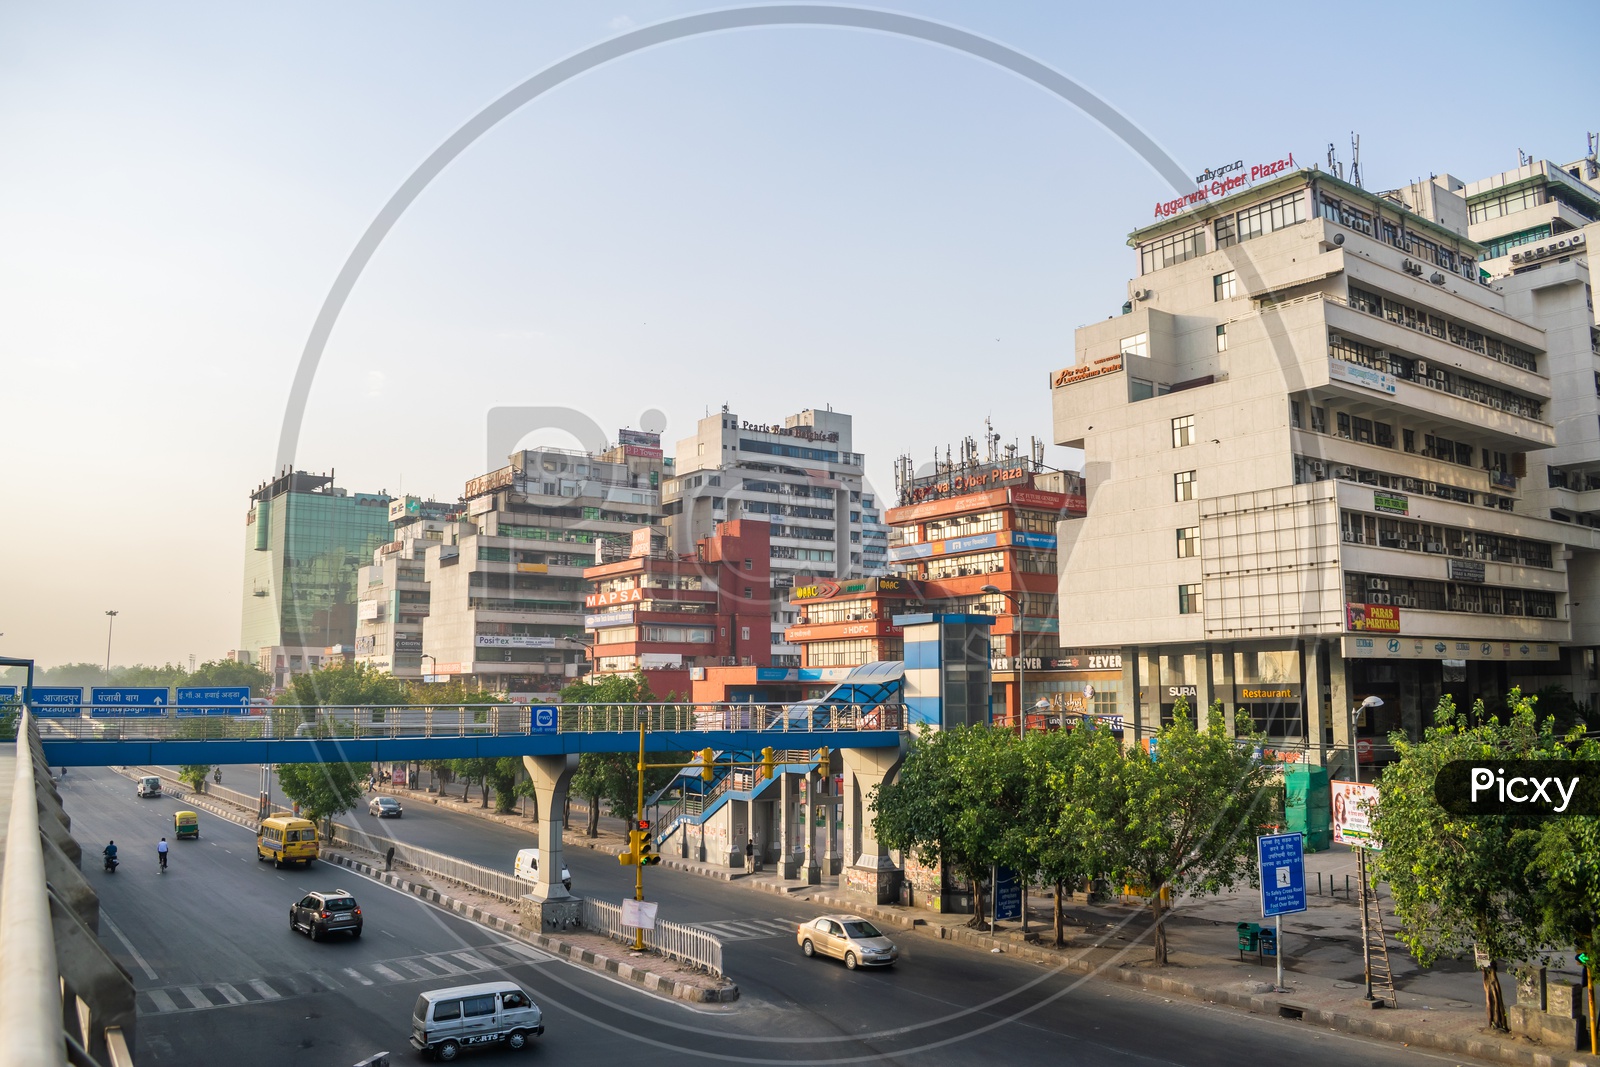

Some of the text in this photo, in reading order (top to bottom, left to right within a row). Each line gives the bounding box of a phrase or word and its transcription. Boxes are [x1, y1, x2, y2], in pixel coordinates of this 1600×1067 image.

[1217, 160, 1243, 177] group
[1154, 185, 1208, 217] Aggarwal
[1211, 173, 1247, 196] Cyber
[743, 421, 769, 434] Pearls
[955, 474, 988, 491] Cyber
[992, 467, 1023, 483] Plaza
[586, 589, 641, 607] MAPSA
[1370, 607, 1393, 619] PARAS
[848, 625, 869, 635] HDFC
[1366, 618, 1400, 631] PARIVAAR
[1088, 655, 1122, 668] ZEVER
[98, 692, 139, 702] पंजाबी बाग
[1169, 686, 1196, 696] SURA
[1243, 689, 1291, 698] Restaurant
[43, 694, 79, 705] आजादपुर
